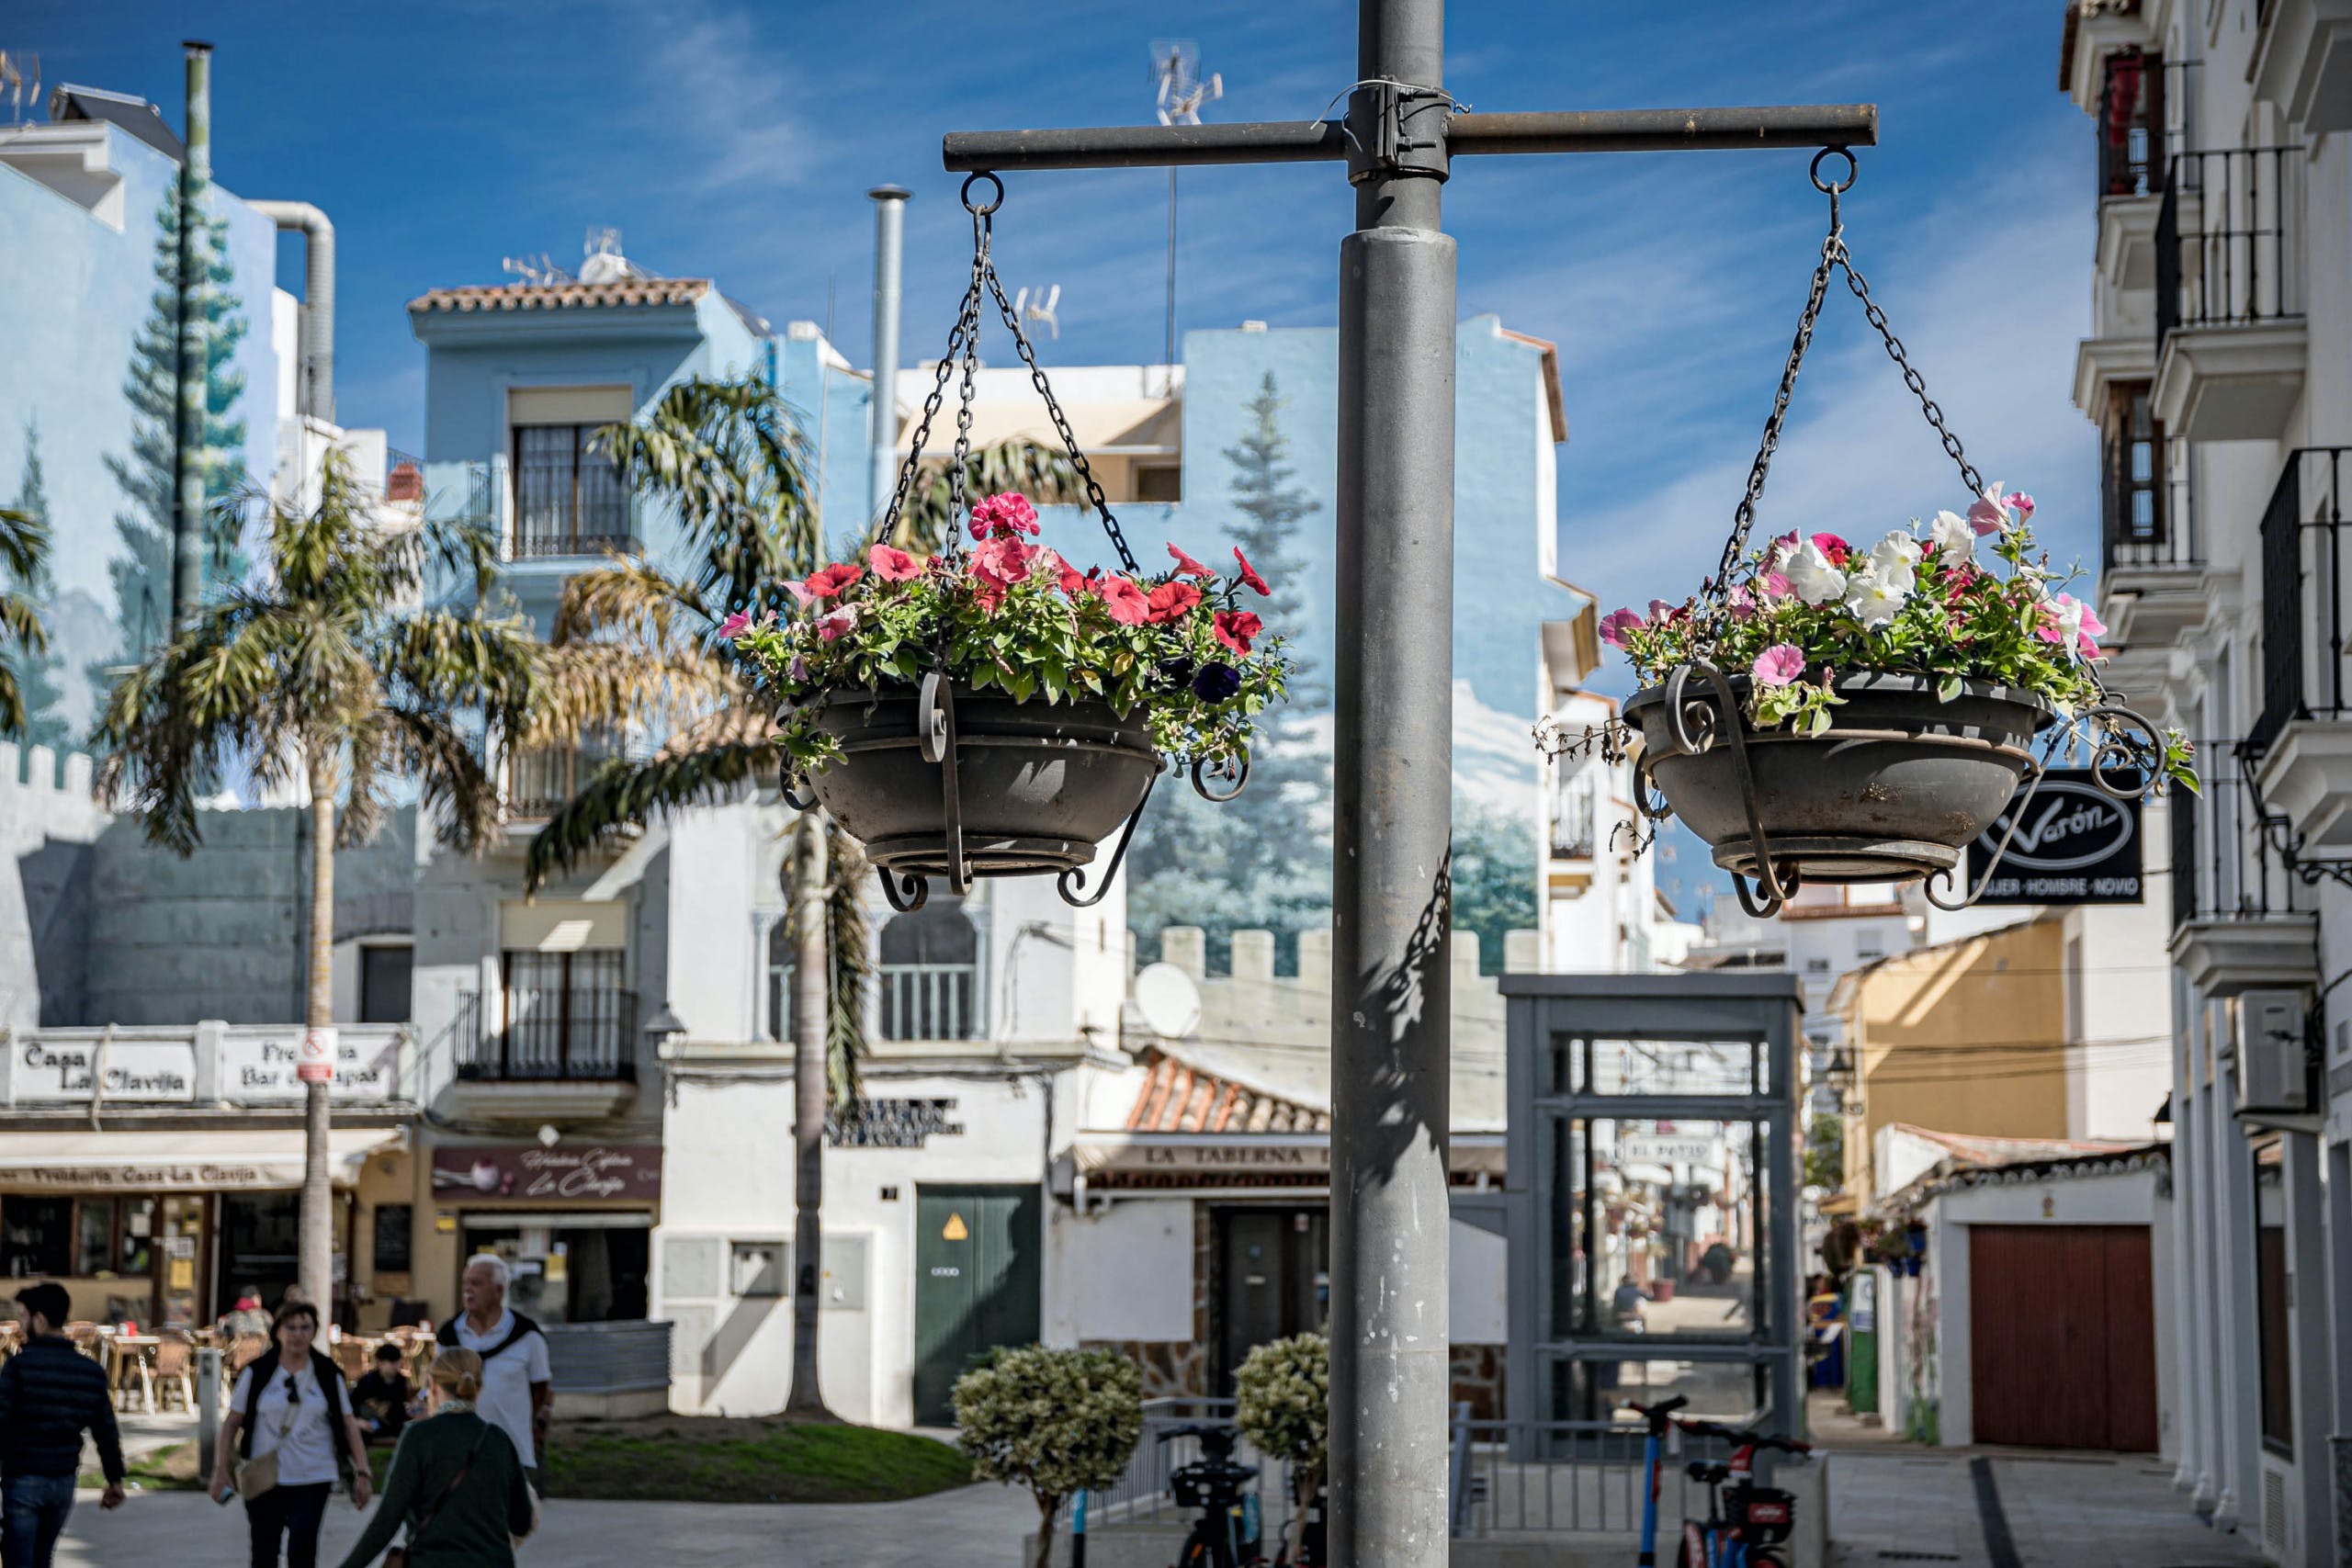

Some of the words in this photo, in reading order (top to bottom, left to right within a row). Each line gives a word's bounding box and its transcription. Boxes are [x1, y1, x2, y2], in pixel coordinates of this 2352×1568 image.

[1995, 796, 2118, 853] Varón
[2026, 877, 2087, 897] HOMBRE
[2093, 877, 2138, 897] NOVIO
[25, 1043, 86, 1067] Casa
[60, 1064, 92, 1090] La
[102, 1068, 186, 1091] Clavija
[242, 1066, 277, 1086] Bar
[1145, 1147, 1176, 1163] LA
[1196, 1147, 1304, 1163] TABERNA
